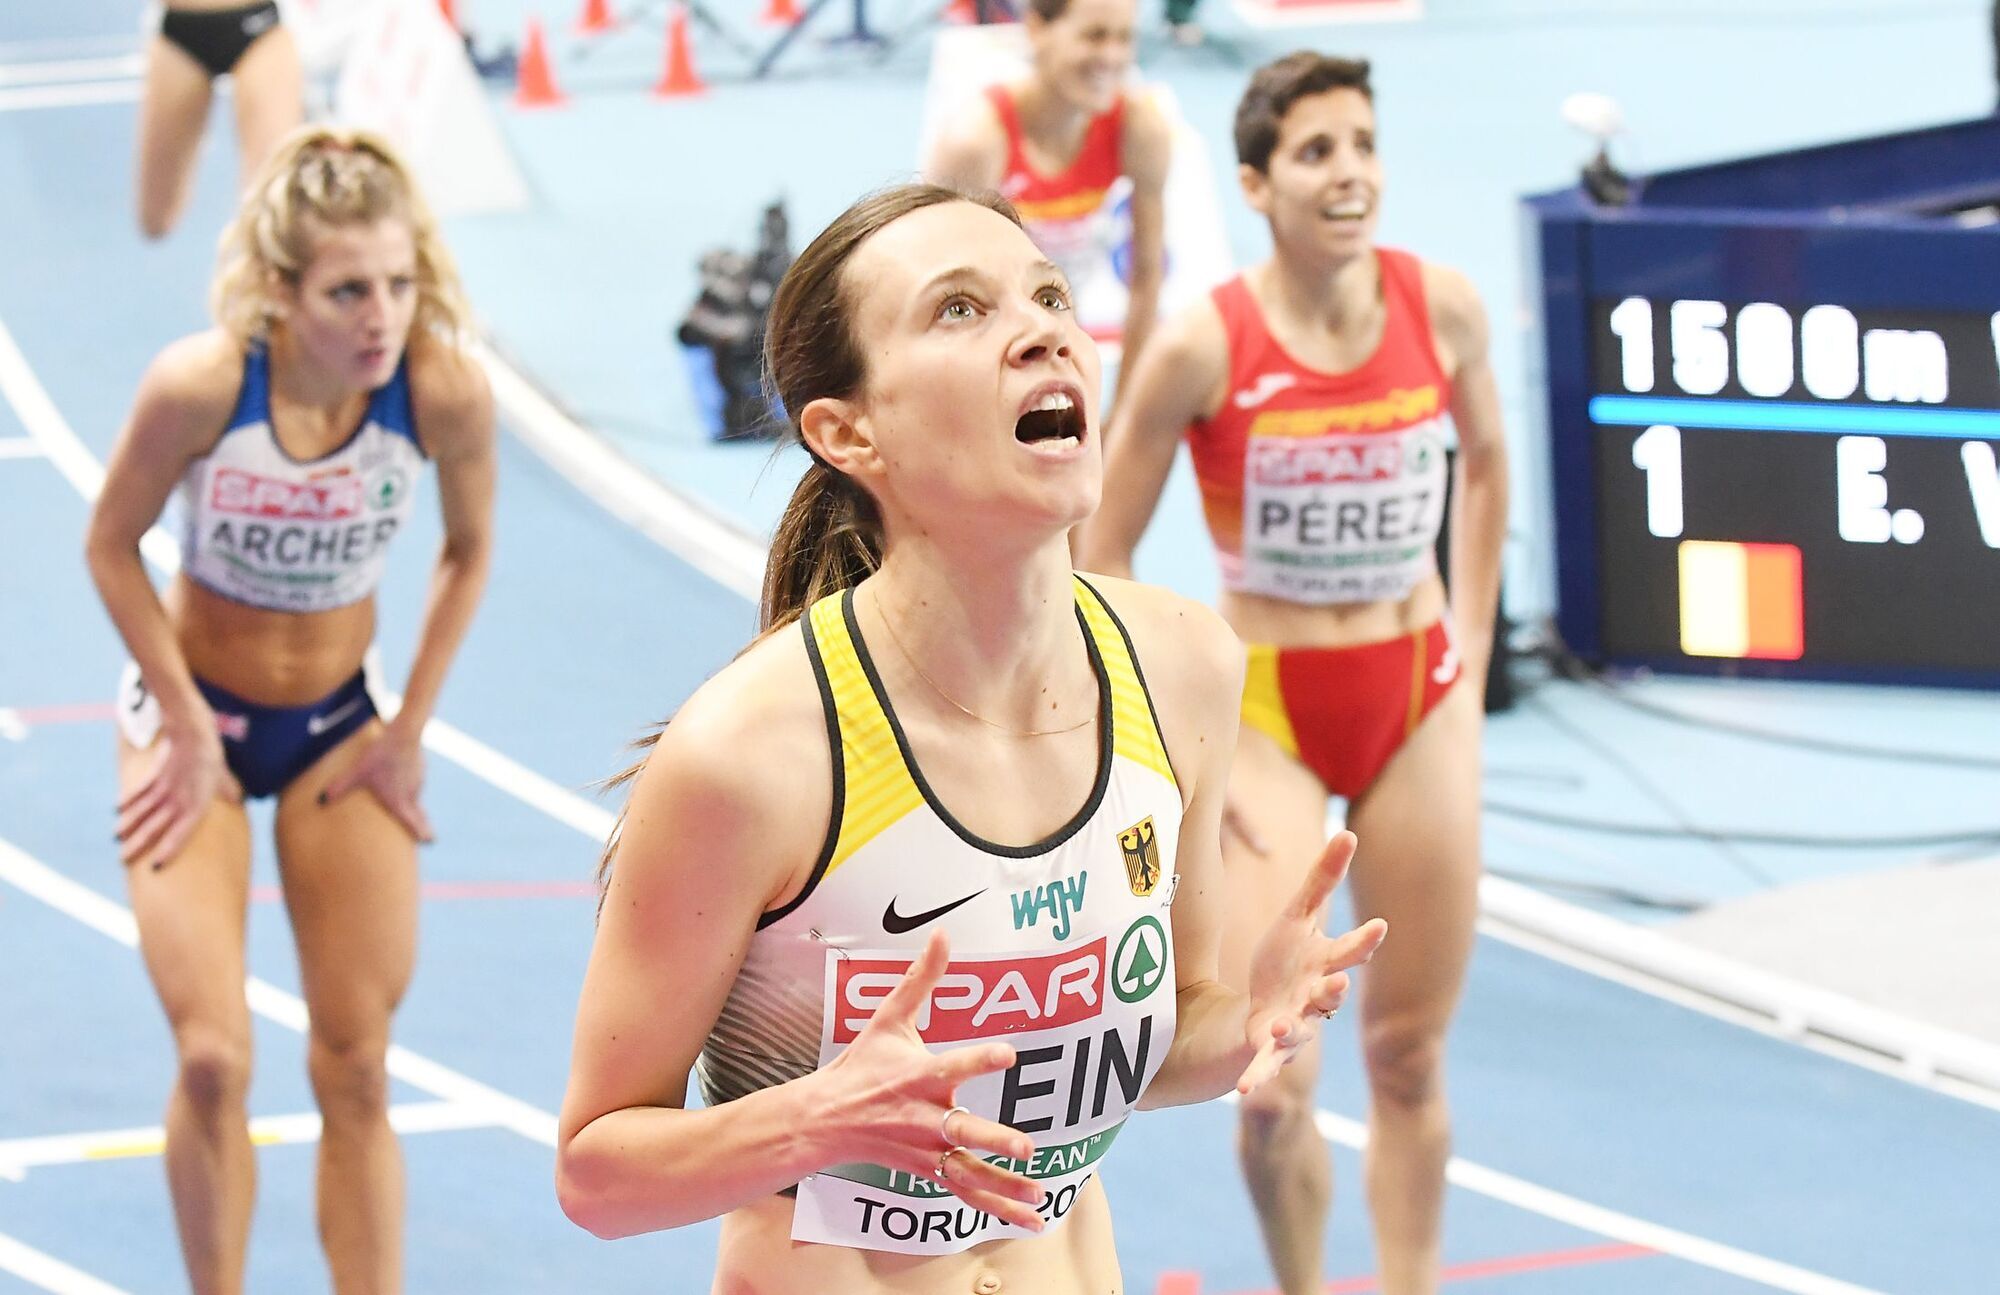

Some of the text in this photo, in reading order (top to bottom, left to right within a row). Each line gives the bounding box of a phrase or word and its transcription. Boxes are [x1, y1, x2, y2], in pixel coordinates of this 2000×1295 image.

[1610, 296, 1949, 403] 1500m
[1259, 492, 1430, 546] PÉREZ
[1632, 425, 1684, 538] 1
[1836, 435, 1925, 545] E.
[211, 516, 398, 566] ARCHER
[844, 953, 1101, 1032] SPAR
